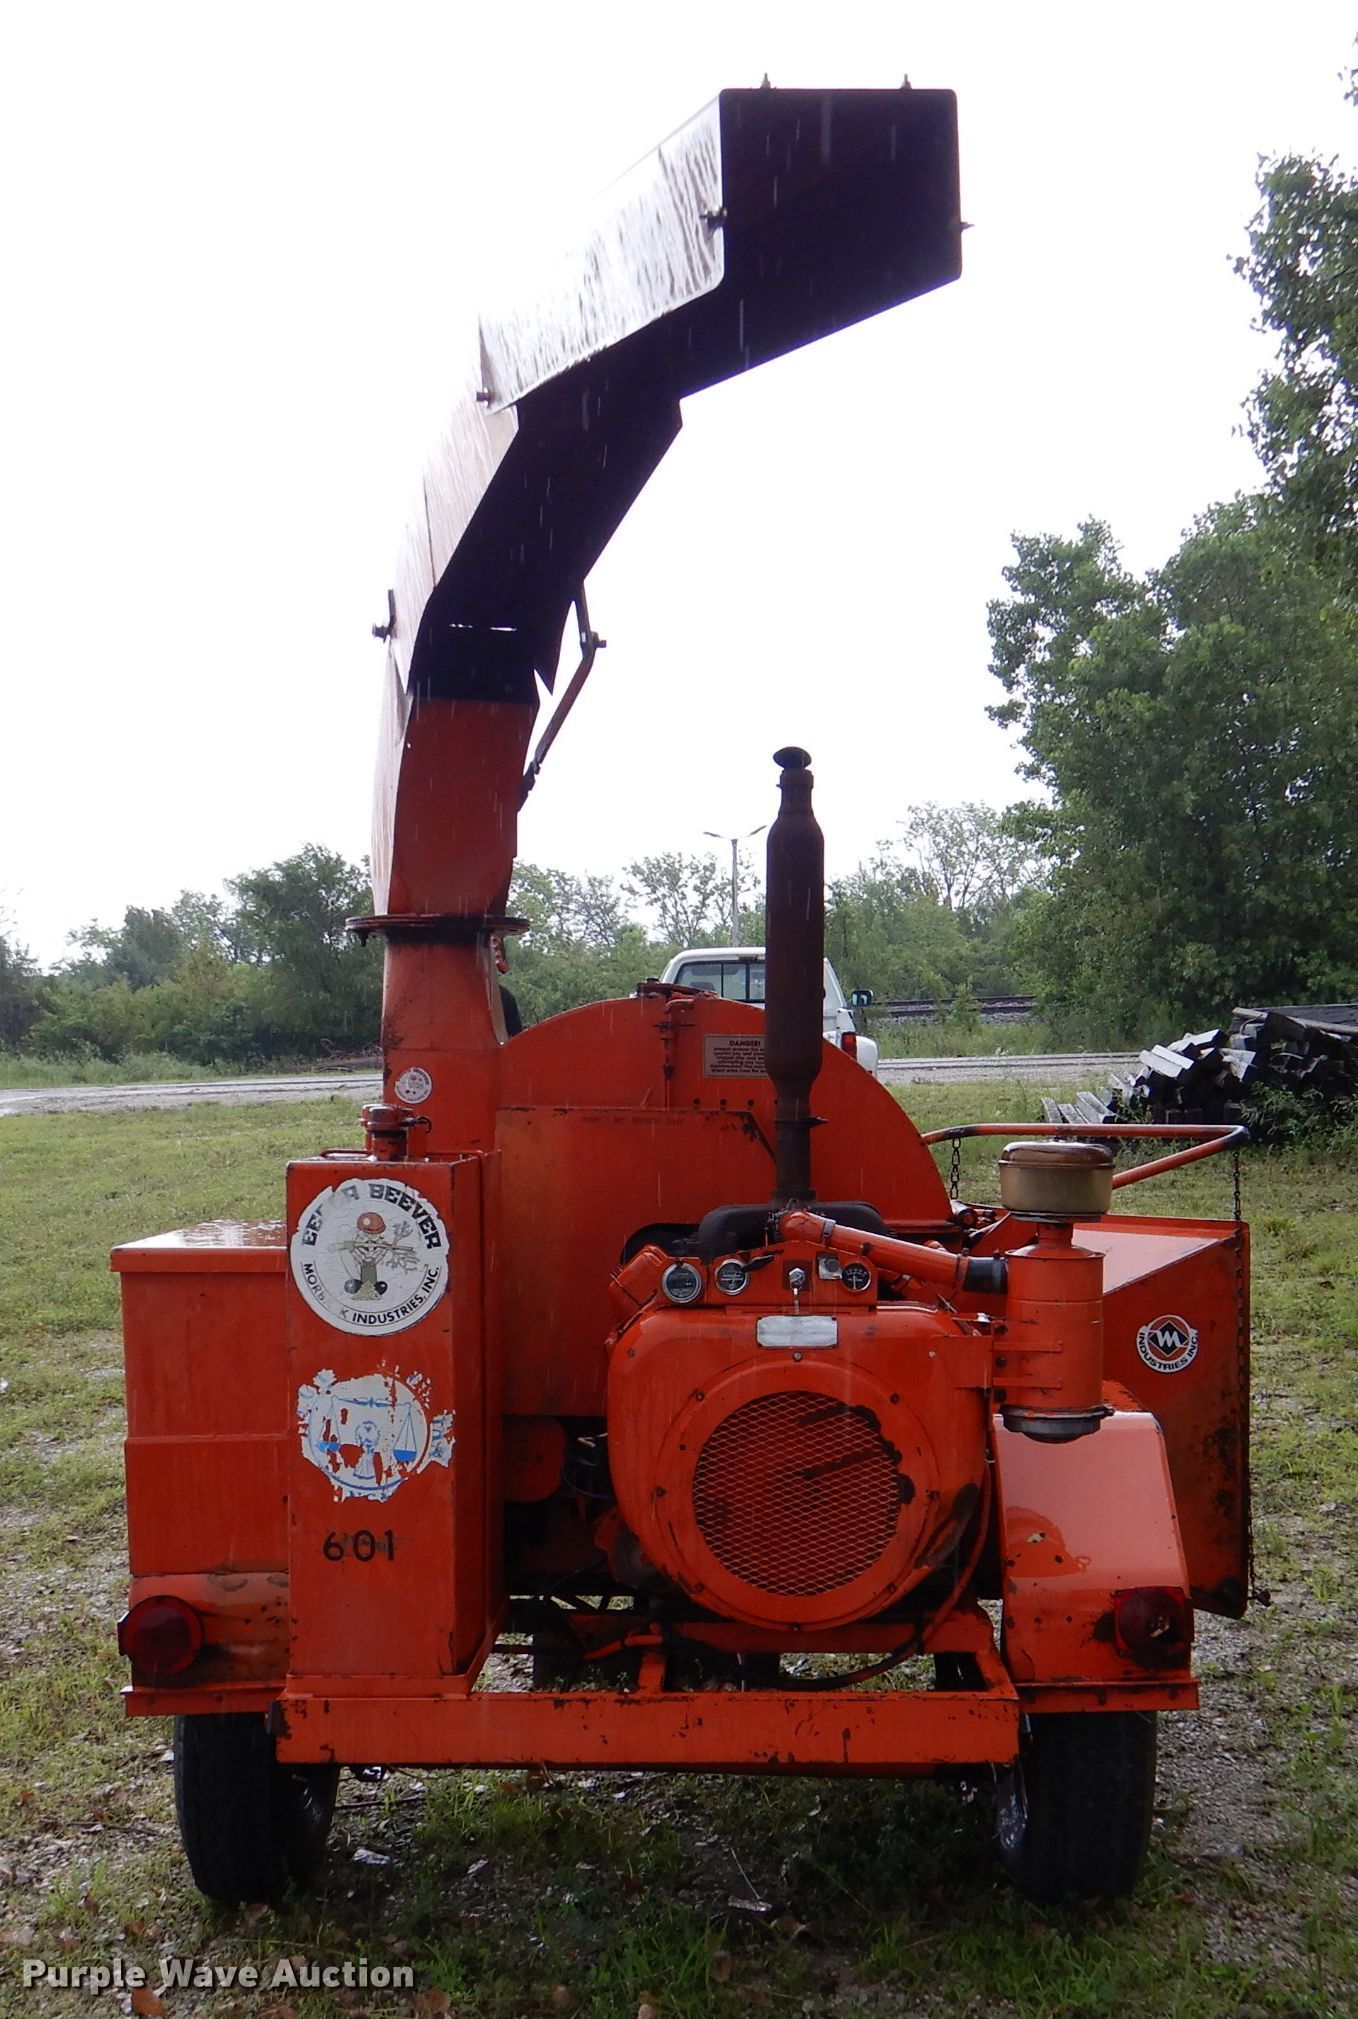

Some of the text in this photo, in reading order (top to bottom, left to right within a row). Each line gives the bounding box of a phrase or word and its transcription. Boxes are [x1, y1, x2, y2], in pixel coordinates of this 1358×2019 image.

[368, 1183, 441, 1249] BEEVER
[352, 1294, 427, 1325] INDUSTRIES,
[421, 1267, 439, 1294] INC.
[1138, 1332, 1188, 1371] INDUSTRIES
[322, 1529, 395, 1562] 601
